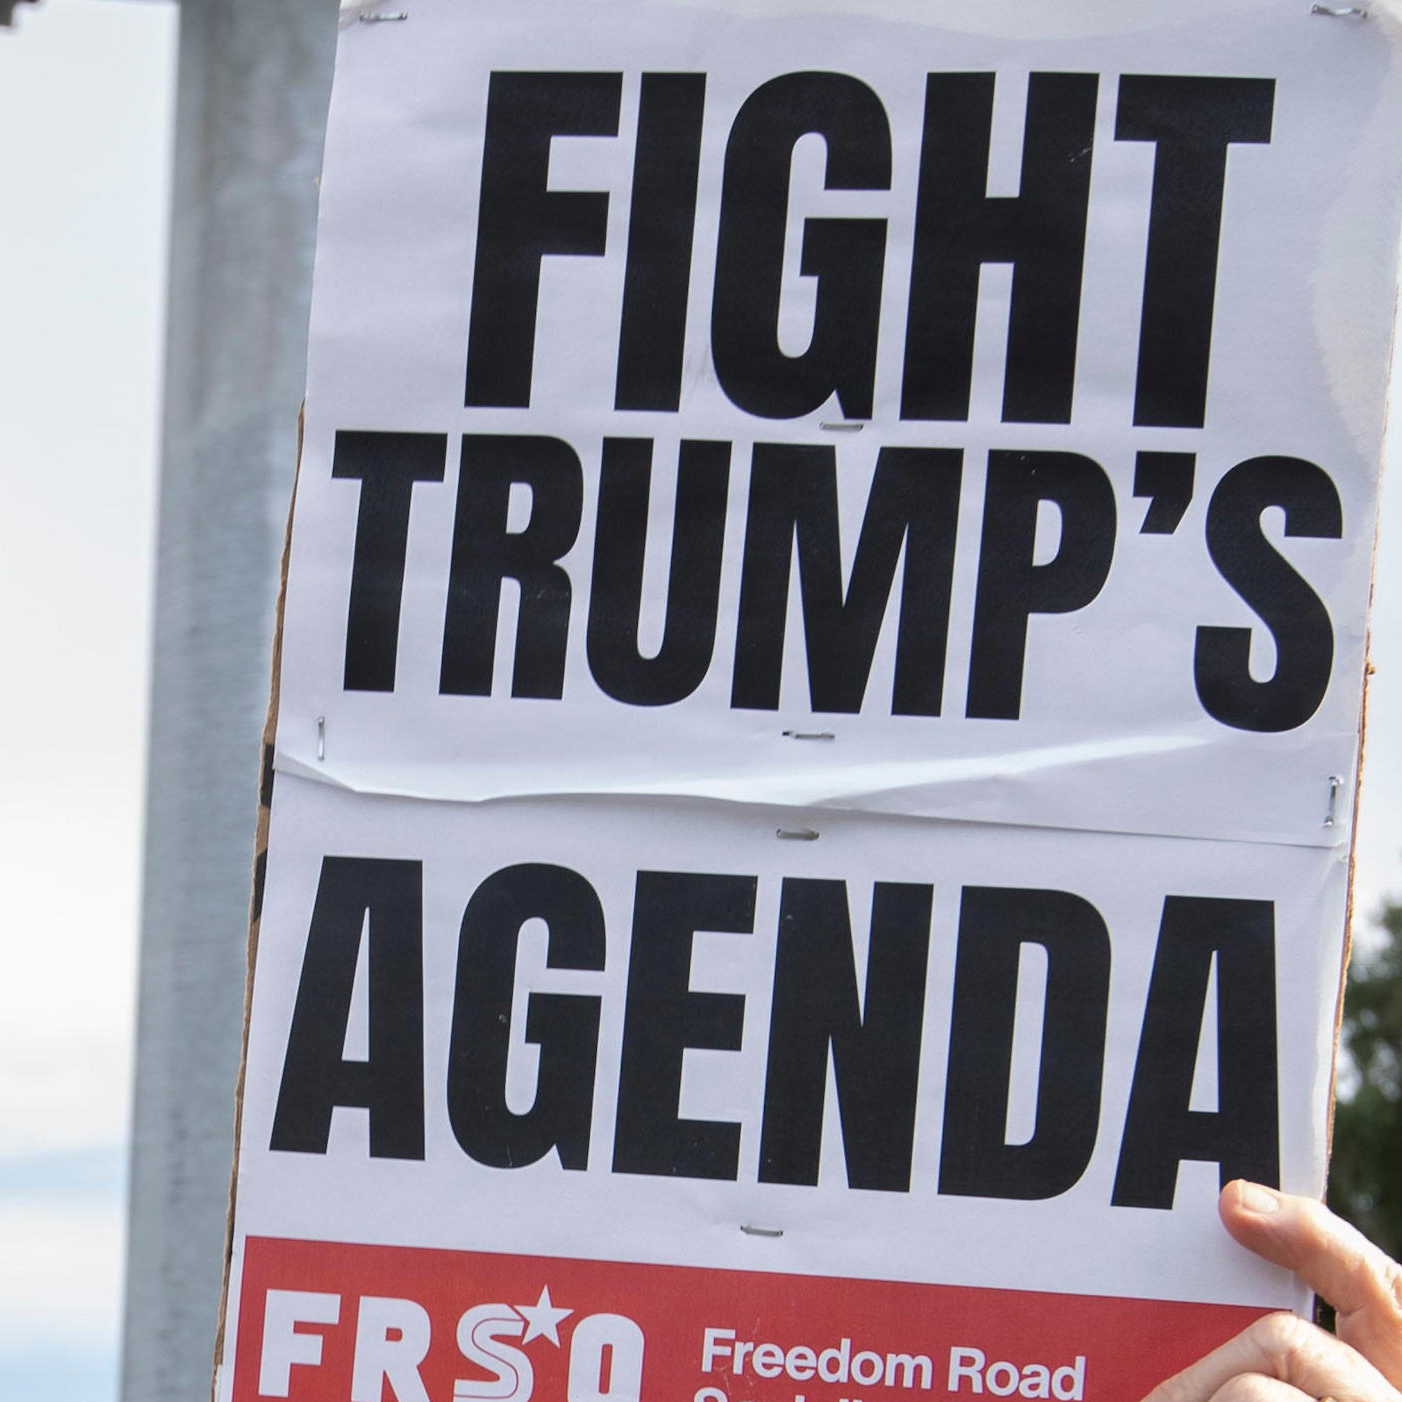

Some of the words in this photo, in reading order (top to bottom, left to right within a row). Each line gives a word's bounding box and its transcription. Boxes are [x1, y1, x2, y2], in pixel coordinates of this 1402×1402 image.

[464, 70, 1277, 429] FIGHT
[270, 856, 1281, 1209] AGENDA
[701, 1327, 933, 1390] Freedom
[947, 1346, 1087, 1402] Road
